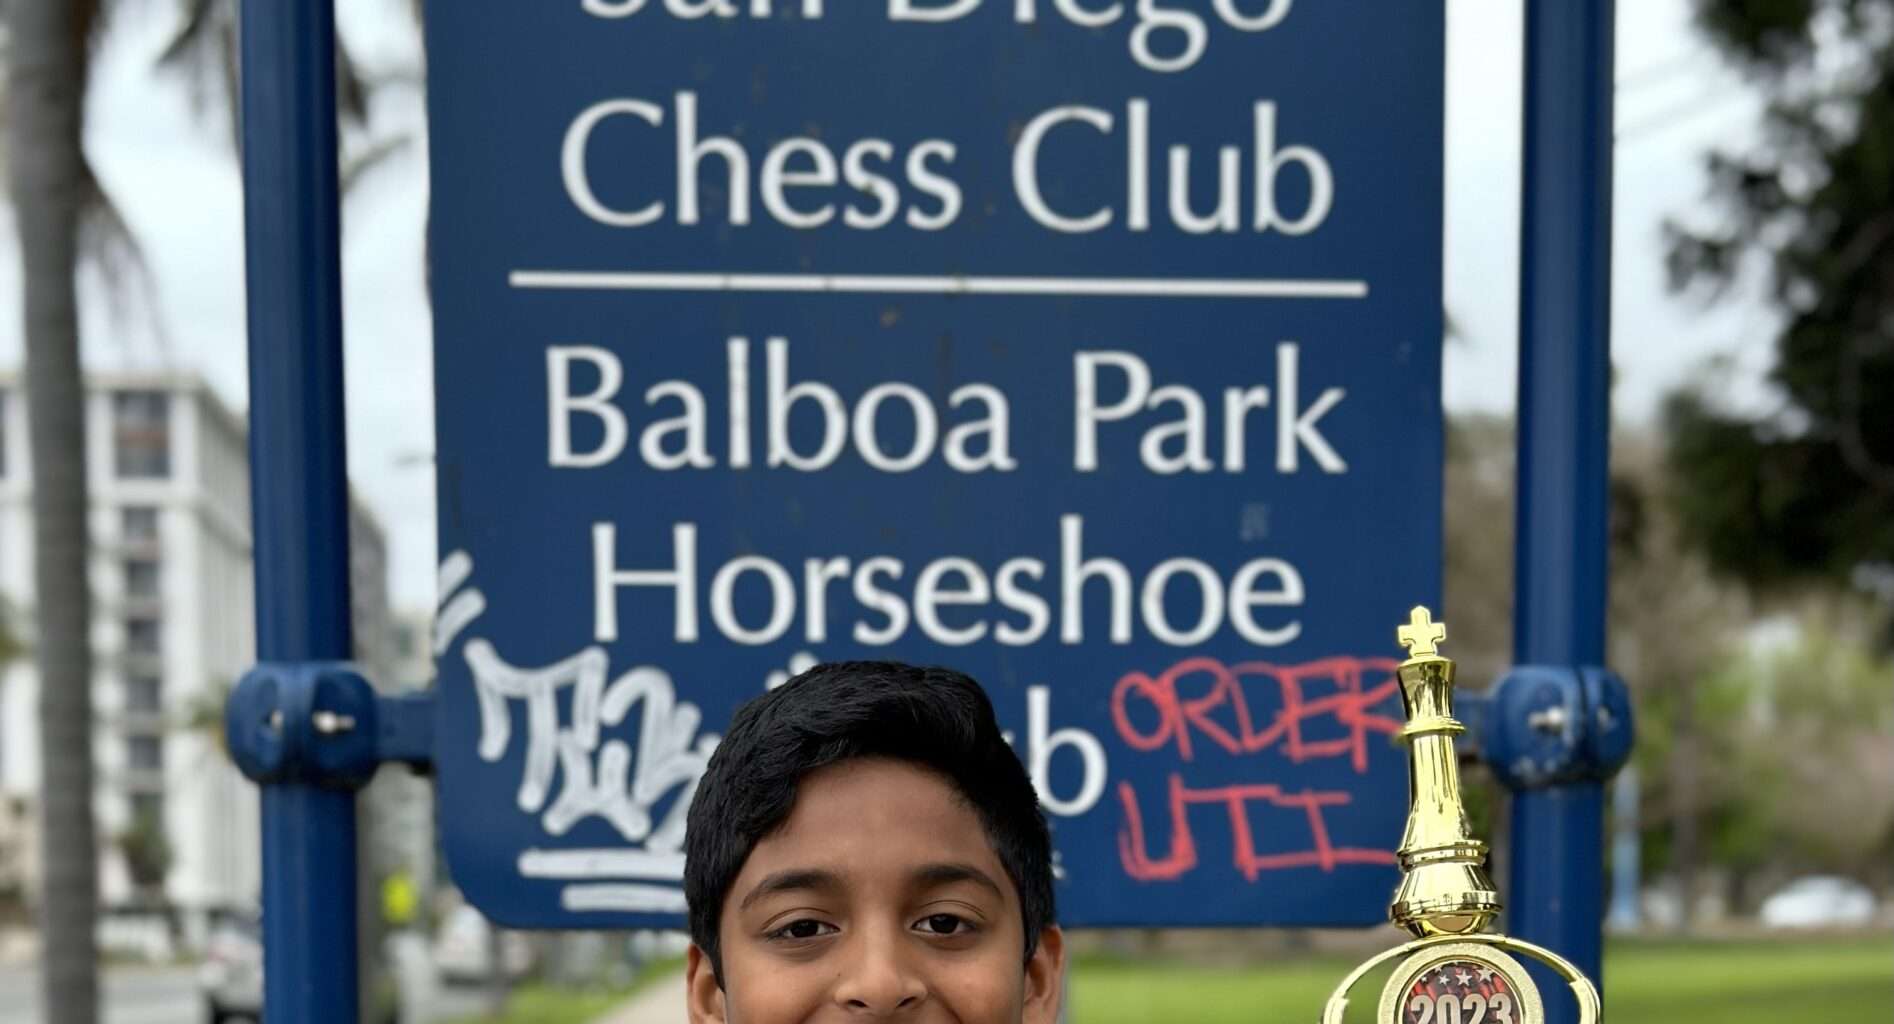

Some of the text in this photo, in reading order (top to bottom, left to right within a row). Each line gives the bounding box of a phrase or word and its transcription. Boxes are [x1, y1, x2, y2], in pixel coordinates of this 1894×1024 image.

[562, 92, 1332, 234] Chess Club
[547, 337, 1345, 473] Balboa Park
[591, 514, 1304, 648] Horseshoe
[1110, 655, 1401, 774] ORDER
